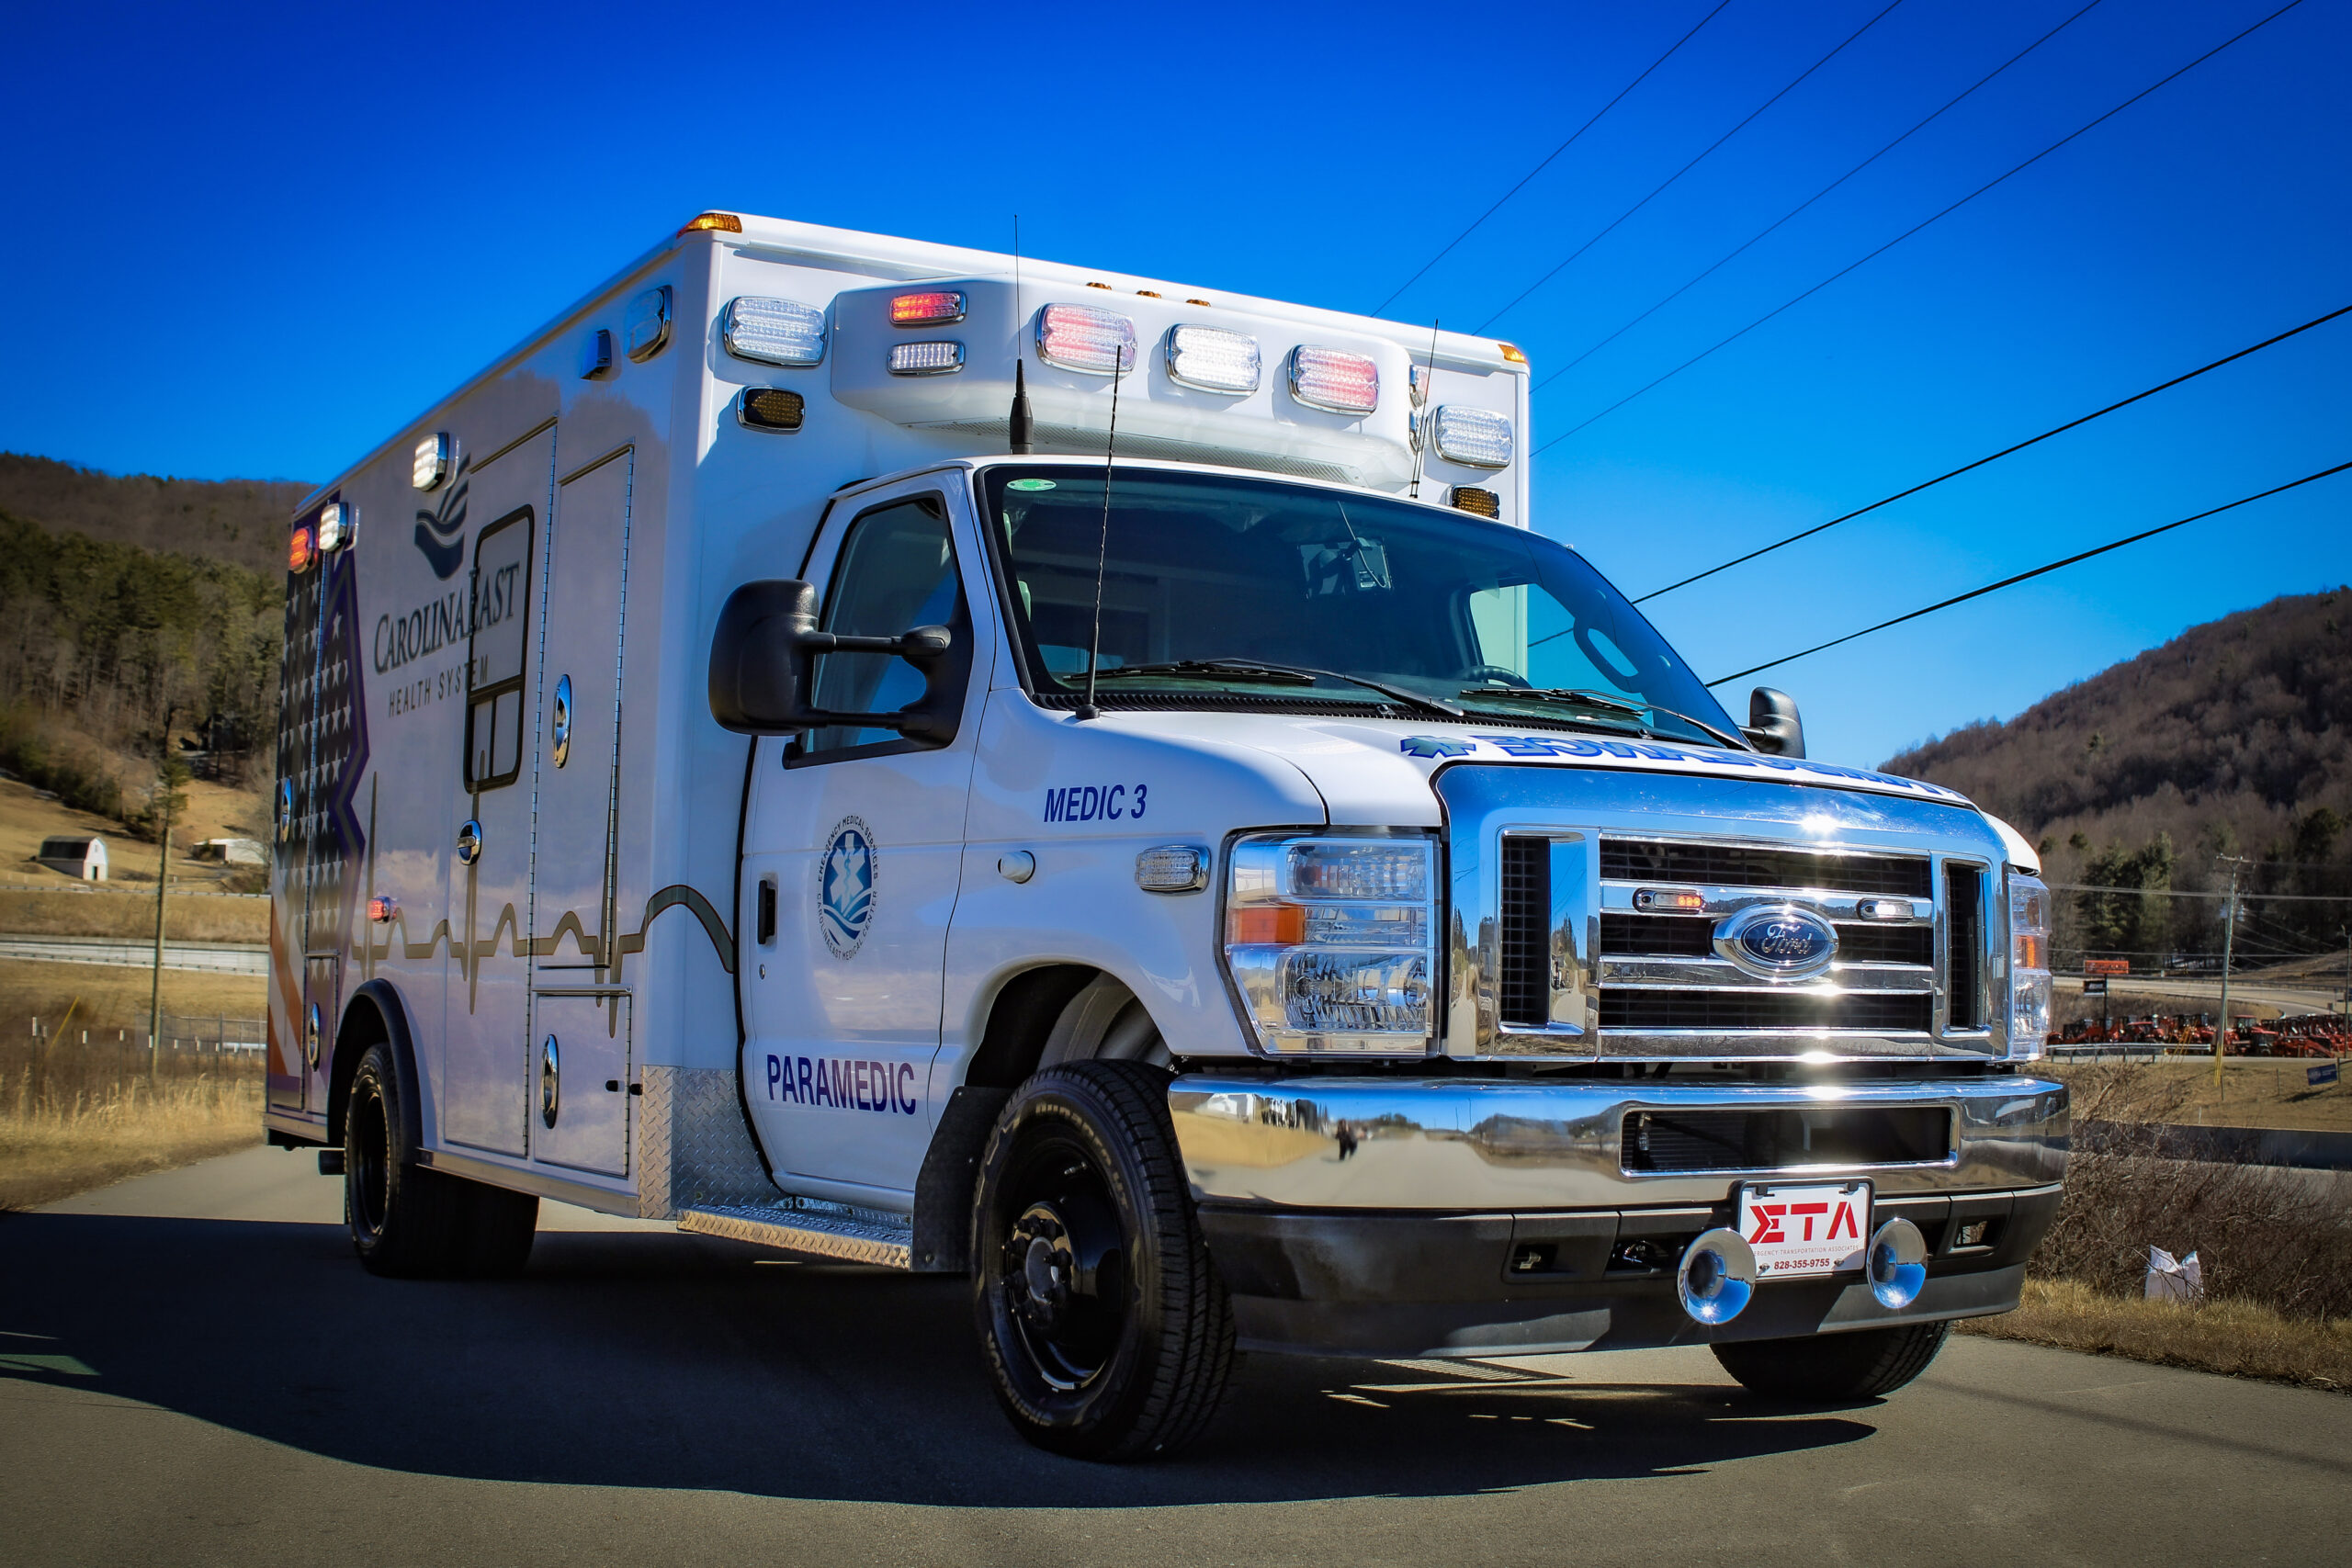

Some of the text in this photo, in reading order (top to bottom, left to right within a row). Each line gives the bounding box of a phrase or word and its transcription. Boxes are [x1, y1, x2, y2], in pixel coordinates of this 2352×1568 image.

[389, 677, 432, 718] HEALTH
[1044, 784, 1148, 823] MEDIC 3
[818, 815, 878, 883] EMERGENCY MEDICAL SERVICES
[842, 939, 863, 962] MEDICAL
[863, 891, 877, 937] CENTER
[1760, 923, 1813, 955] Ford
[766, 1054, 917, 1116] PARAMEDIC
[1773, 1258, 1830, 1270] 828-355-9755
[1781, 1247, 1826, 1256] TRANSPORTATION
[1828, 1245, 1860, 1254] ASSOCIATES
